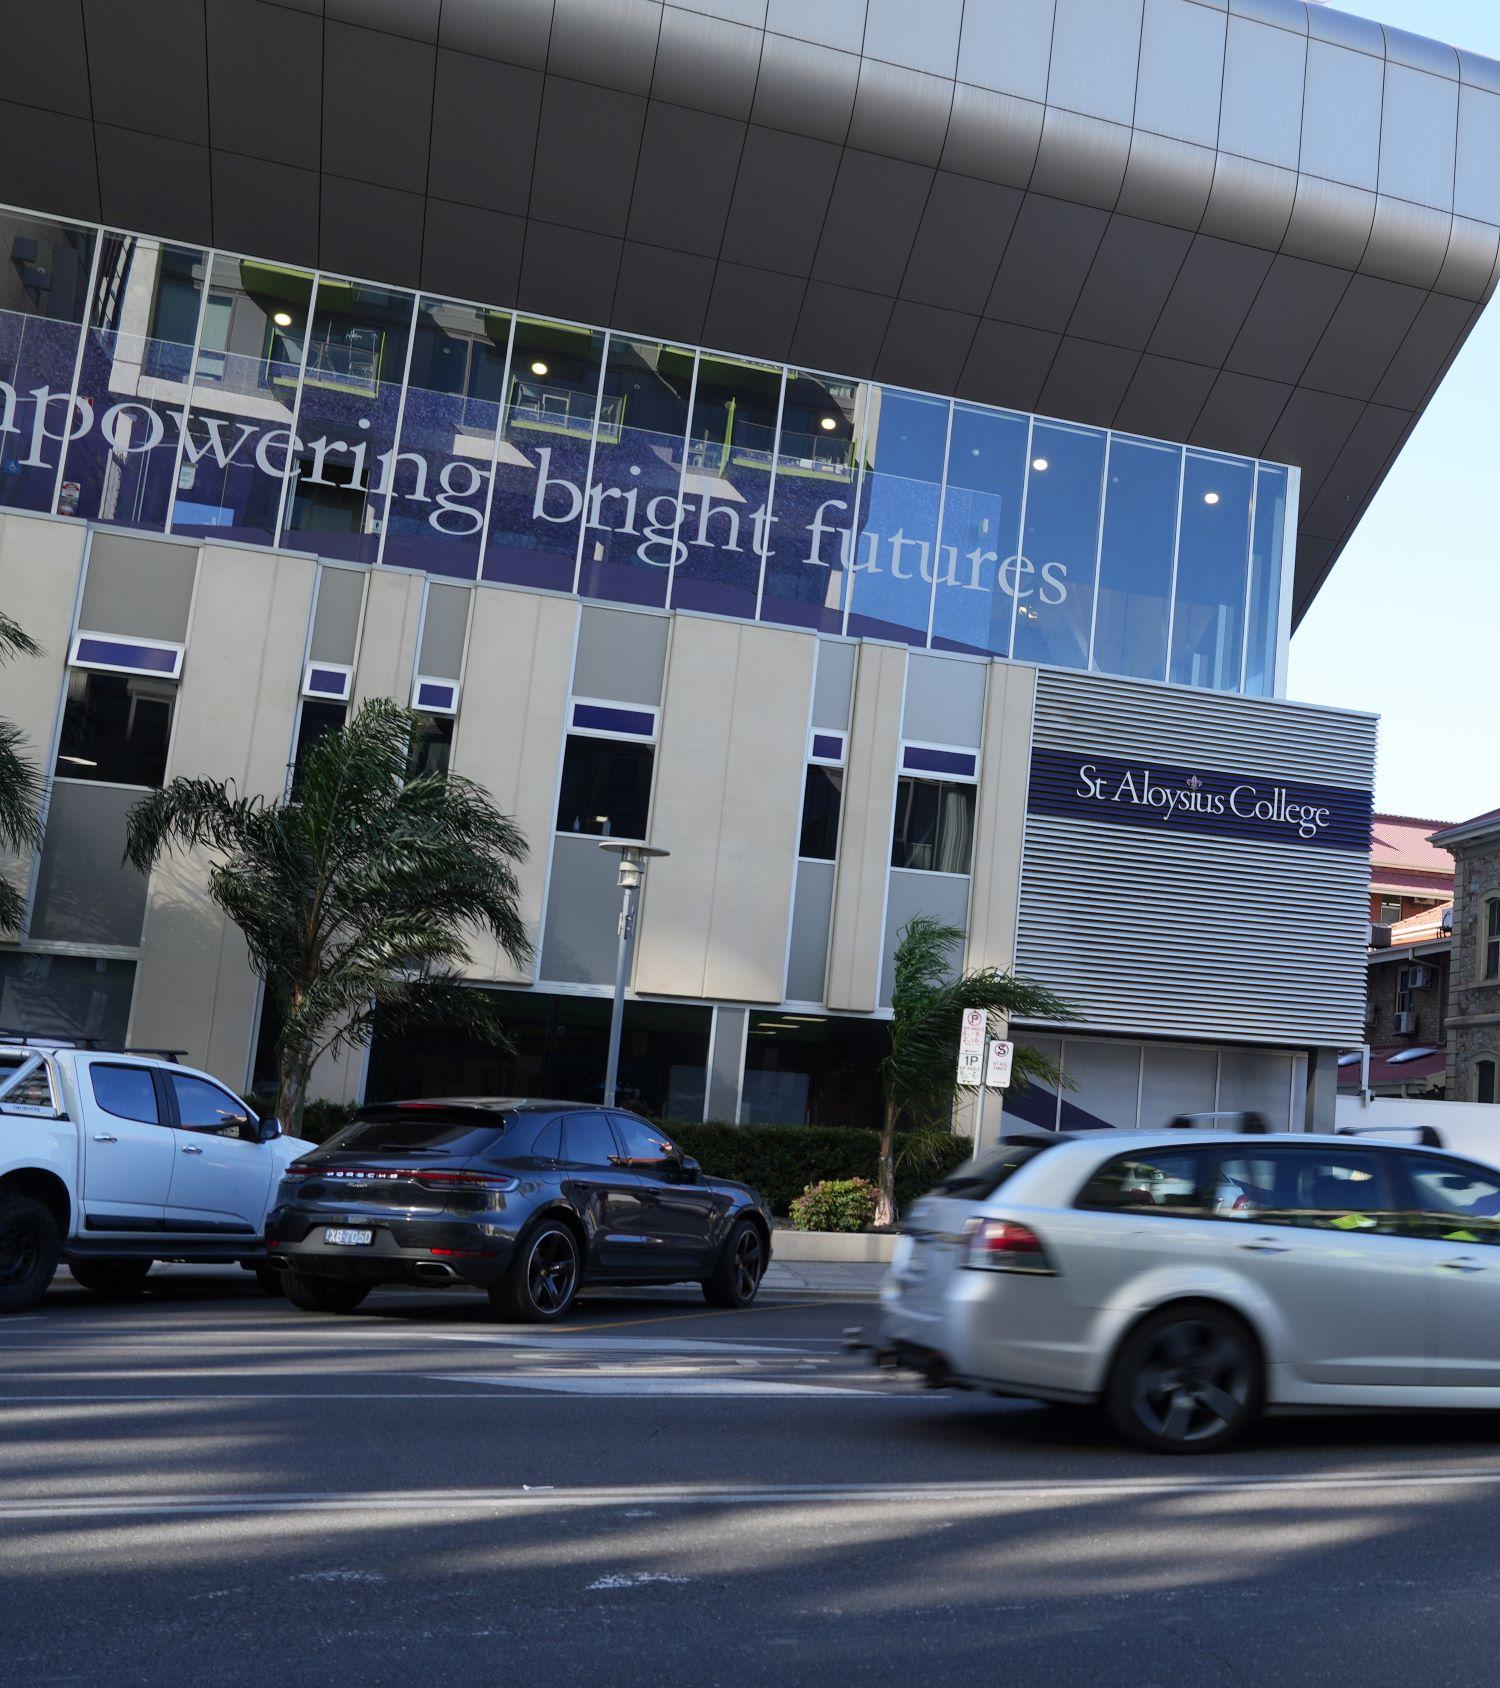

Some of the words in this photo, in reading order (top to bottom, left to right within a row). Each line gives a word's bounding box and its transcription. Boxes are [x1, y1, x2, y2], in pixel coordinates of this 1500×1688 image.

[0, 381, 491, 535] powering
[533, 448, 778, 567] bright
[802, 500, 1068, 604] futures
[1076, 764, 1107, 800] St
[1111, 770, 1225, 820] Aloysius
[1229, 785, 1330, 838] College
[965, 1055, 979, 1066] 1P
[326, 1171, 398, 1179] PORSCHE
